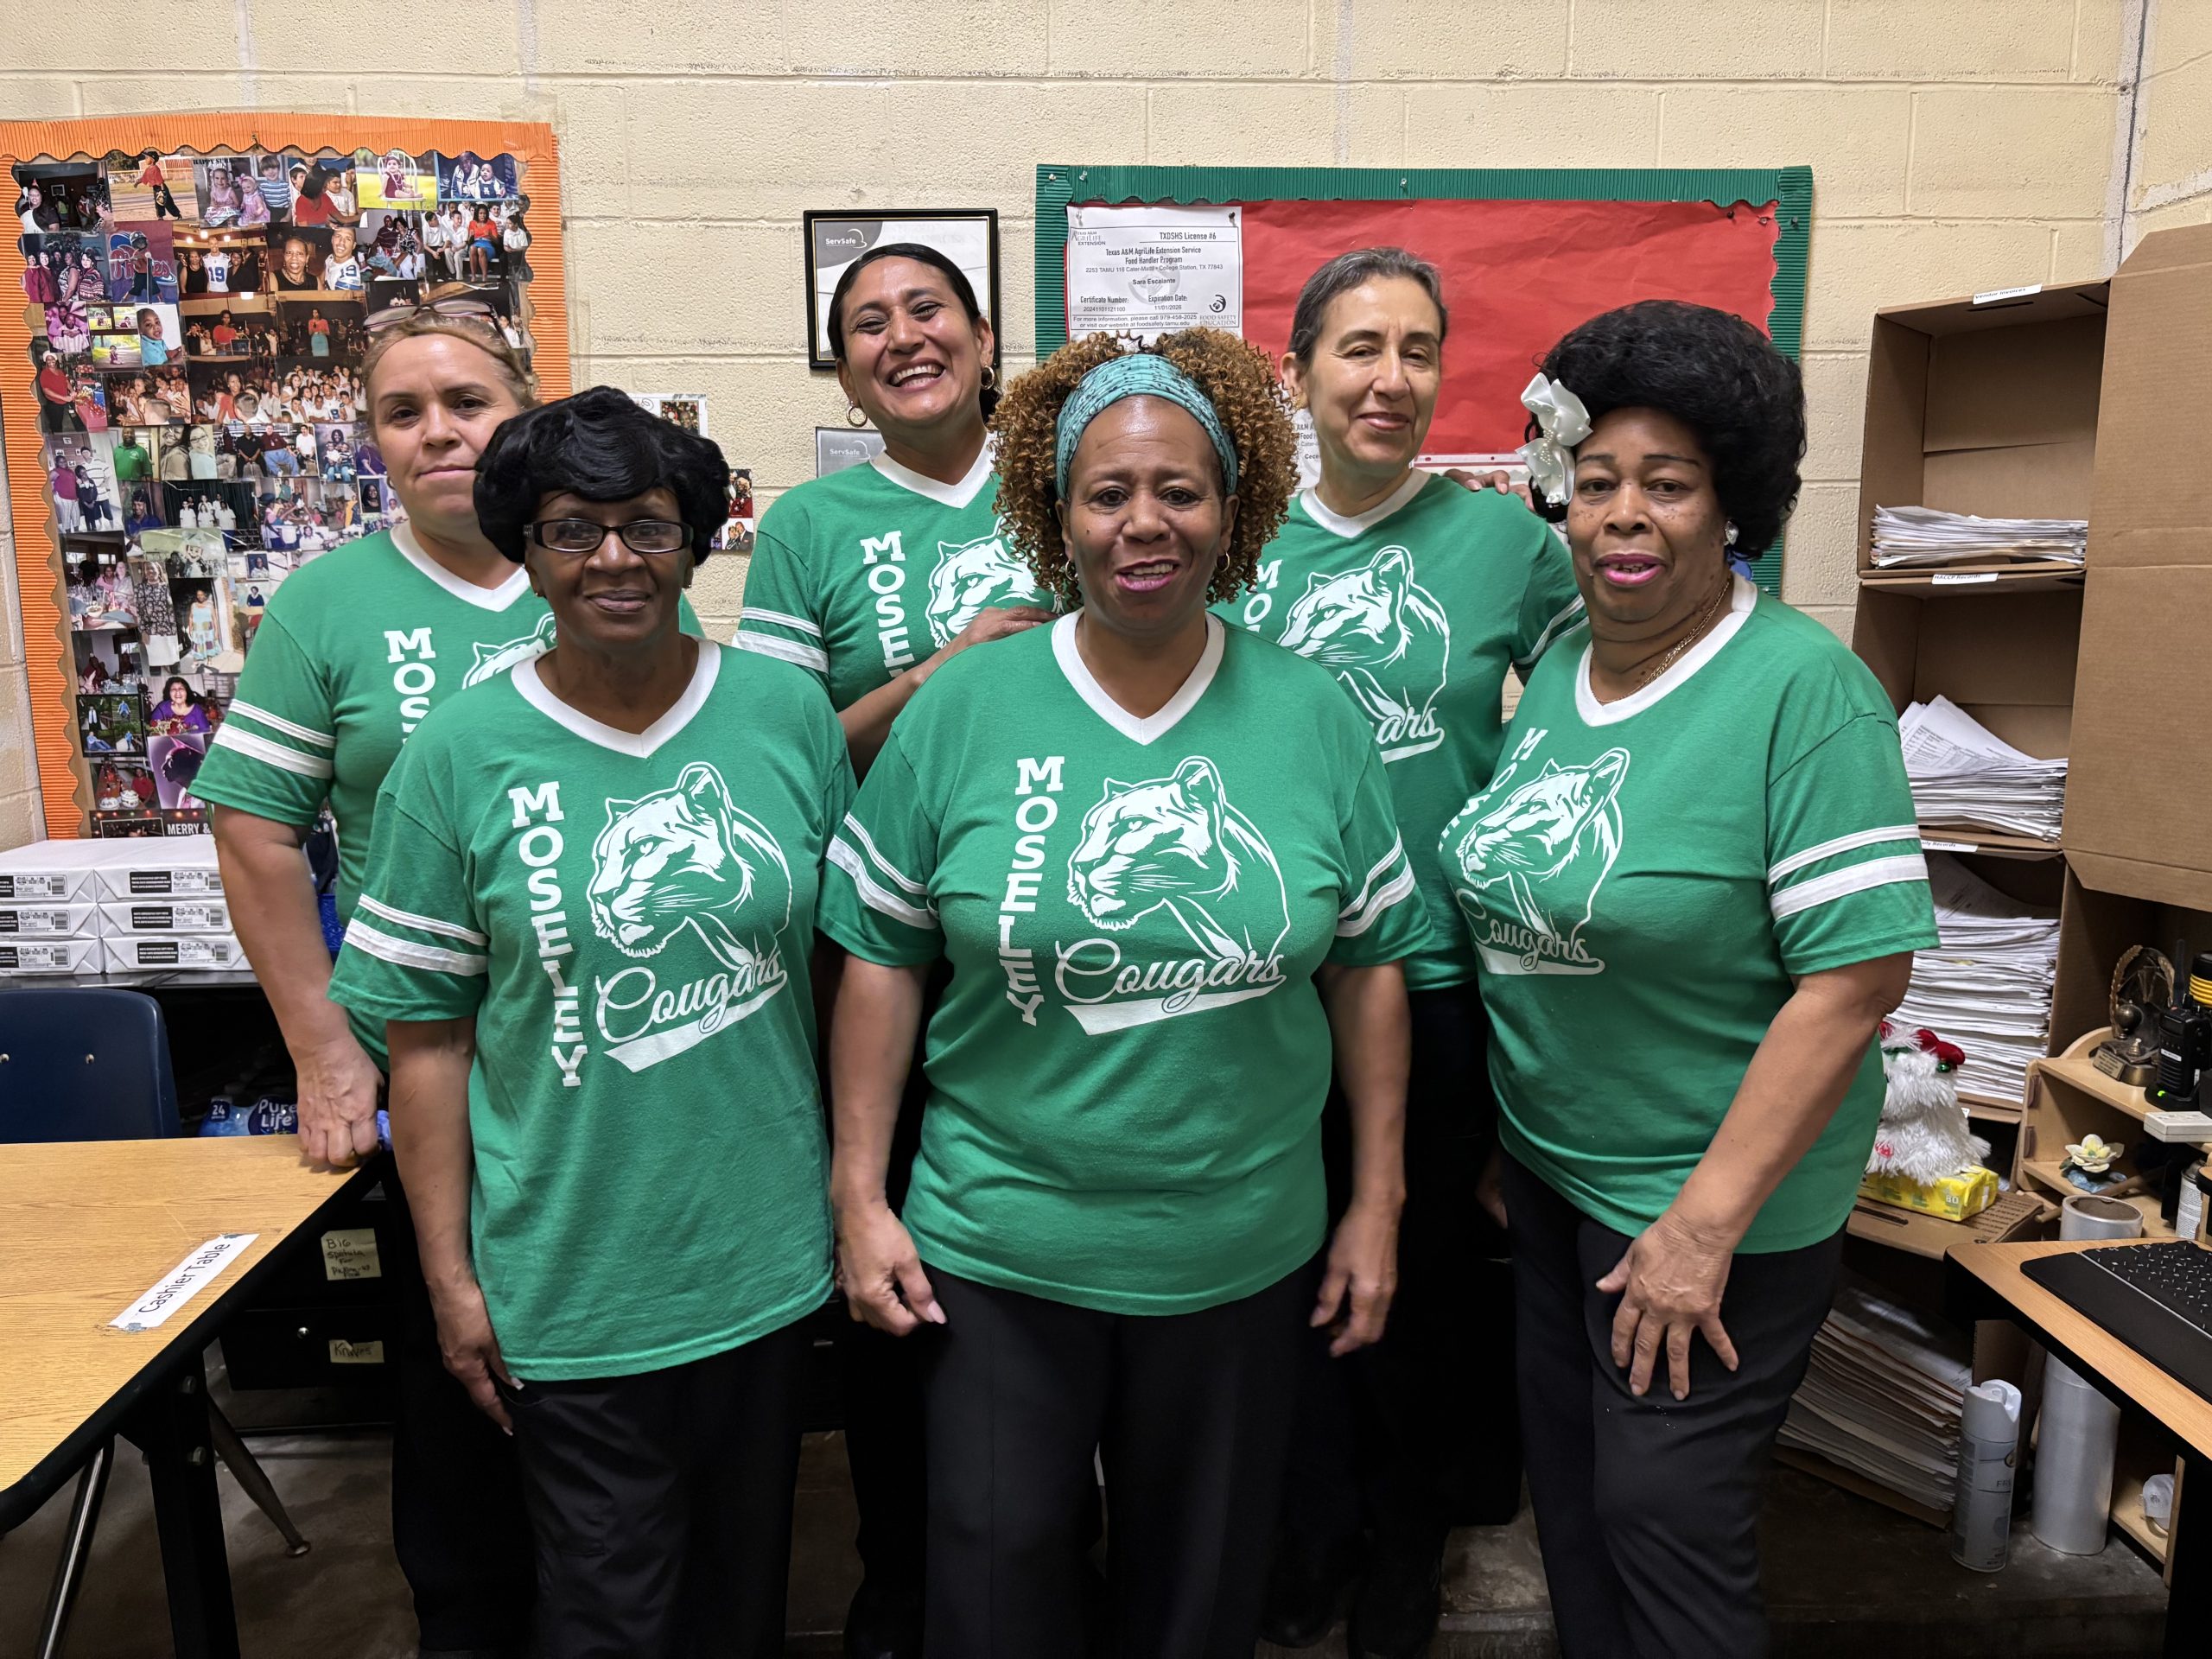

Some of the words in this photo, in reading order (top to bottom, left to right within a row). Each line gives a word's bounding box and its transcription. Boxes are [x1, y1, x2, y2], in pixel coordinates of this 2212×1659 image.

[1159, 232, 1183, 240] TXDSHS
[1184, 232, 1208, 240] License
[1209, 232, 1217, 240] #6
[208, 266, 225, 283] 19
[339, 264, 357, 278] 19
[1107, 296, 1129, 304] Number:
[1148, 295, 1173, 303] Expiration
[859, 530, 915, 677] MOSE
[167, 823, 200, 836] MERRY
[202, 822, 212, 834] &
[997, 755, 1065, 1027] MOSELEY
[508, 780, 588, 1087] MOSELEY
[1455, 887, 1594, 971] Cougars
[1054, 938, 1287, 1014] Cougars
[595, 949, 787, 1043] Cougars
[212, 1105, 225, 1116] 24
[258, 1098, 297, 1115] Pure
[261, 1113, 292, 1130] Life
[138, 1274, 197, 1313] Cashier
[183, 1243, 231, 1273] Table
